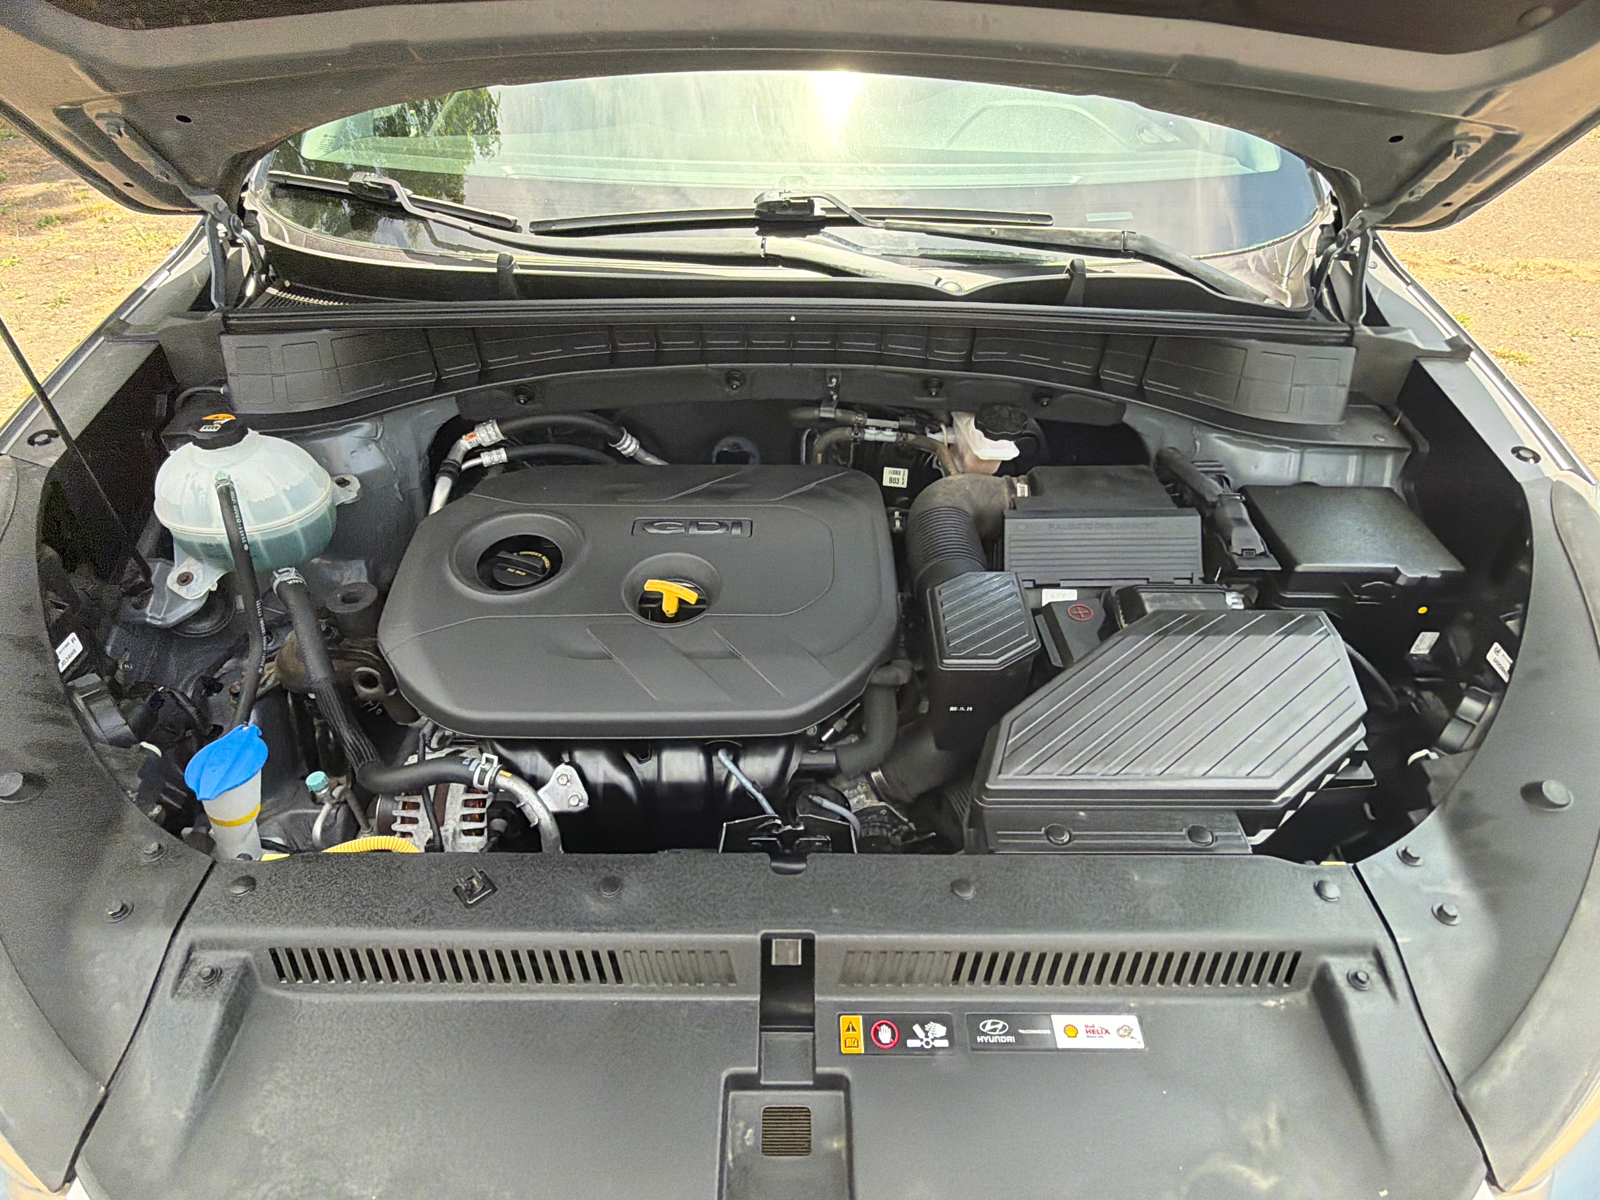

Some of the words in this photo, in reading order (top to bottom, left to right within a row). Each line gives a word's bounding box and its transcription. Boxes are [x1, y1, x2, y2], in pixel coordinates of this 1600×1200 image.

[889, 476, 900, 485] B03
[643, 520, 743, 535] GDI
[1085, 1028, 1111, 1036] HELIX
[977, 1035, 1016, 1044] HYUNDAI
